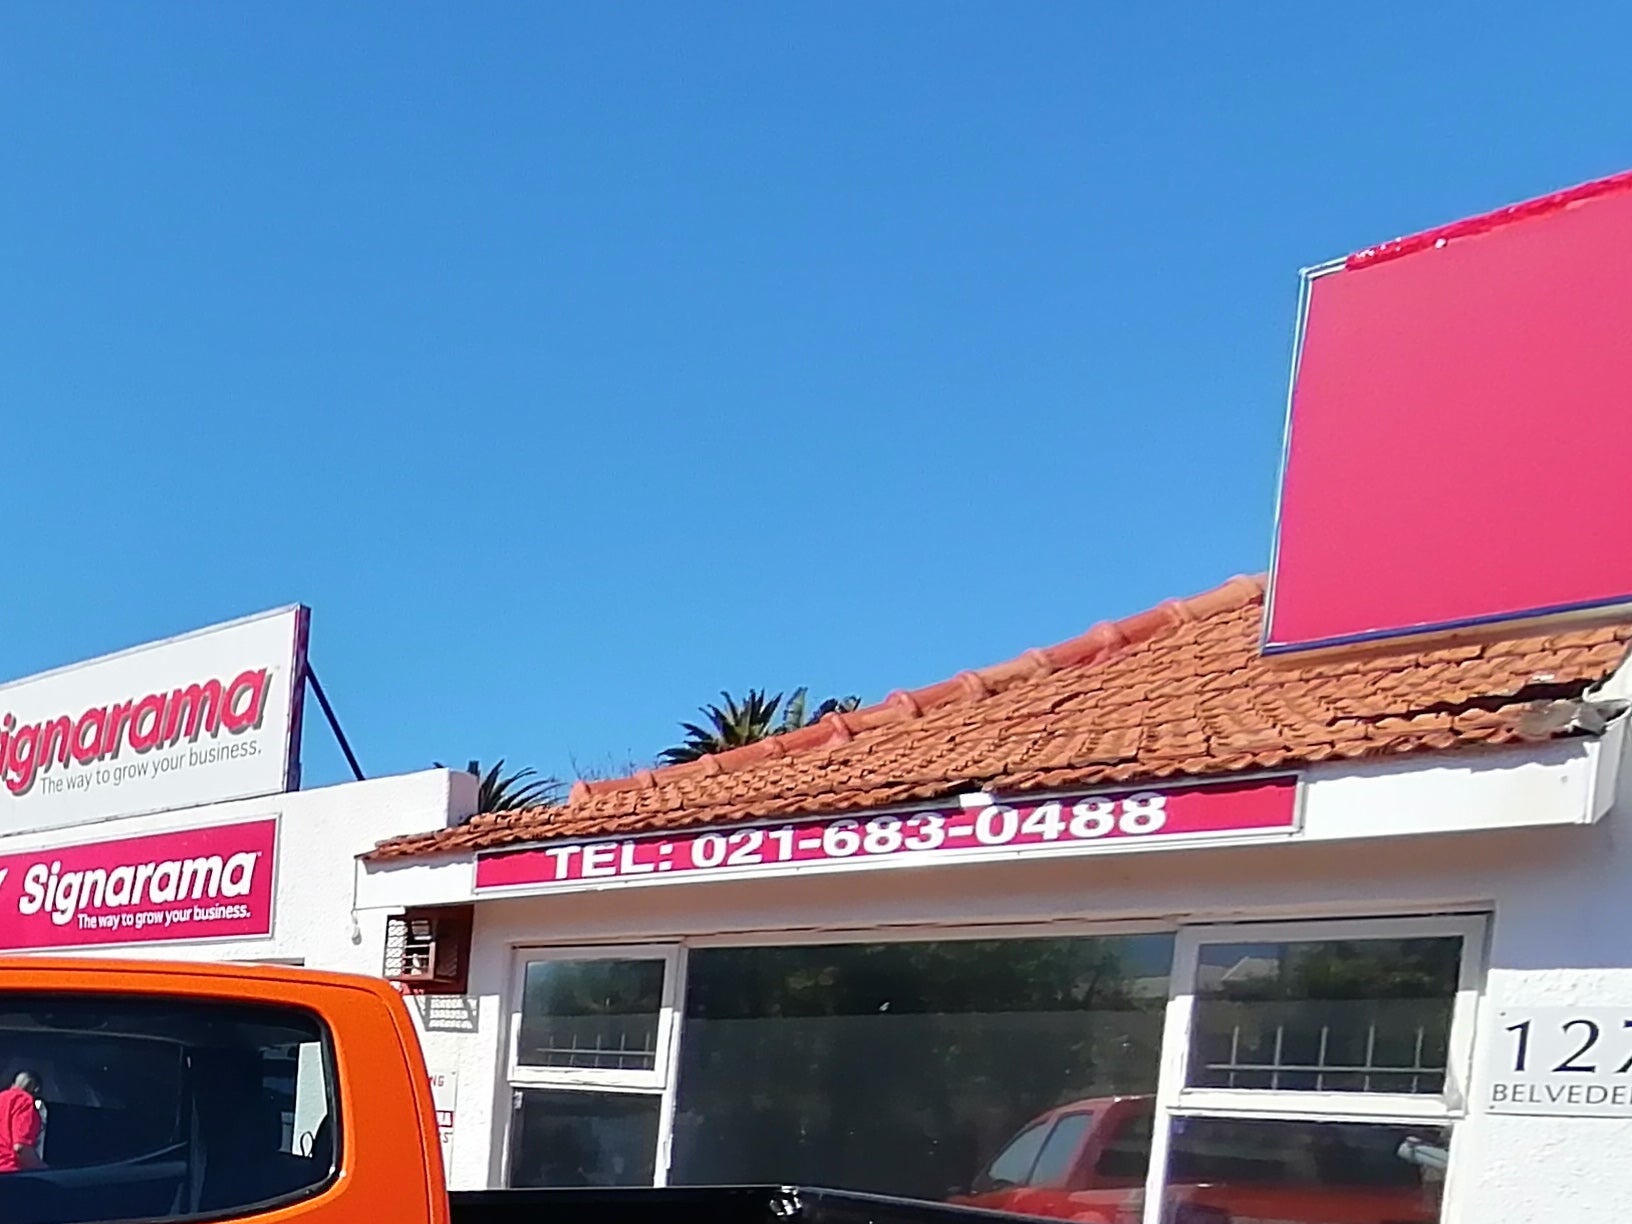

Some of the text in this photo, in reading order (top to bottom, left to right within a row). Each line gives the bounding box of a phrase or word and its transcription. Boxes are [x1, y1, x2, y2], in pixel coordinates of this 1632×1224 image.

[40, 739, 262, 795] The way to grow your business.
[546, 791, 1168, 880] TEL: 021-683-0488
[18, 852, 258, 925] Signarama
[77, 903, 251, 930] The way to grow your business.
[1492, 1083, 1632, 1105] BELVEDE
